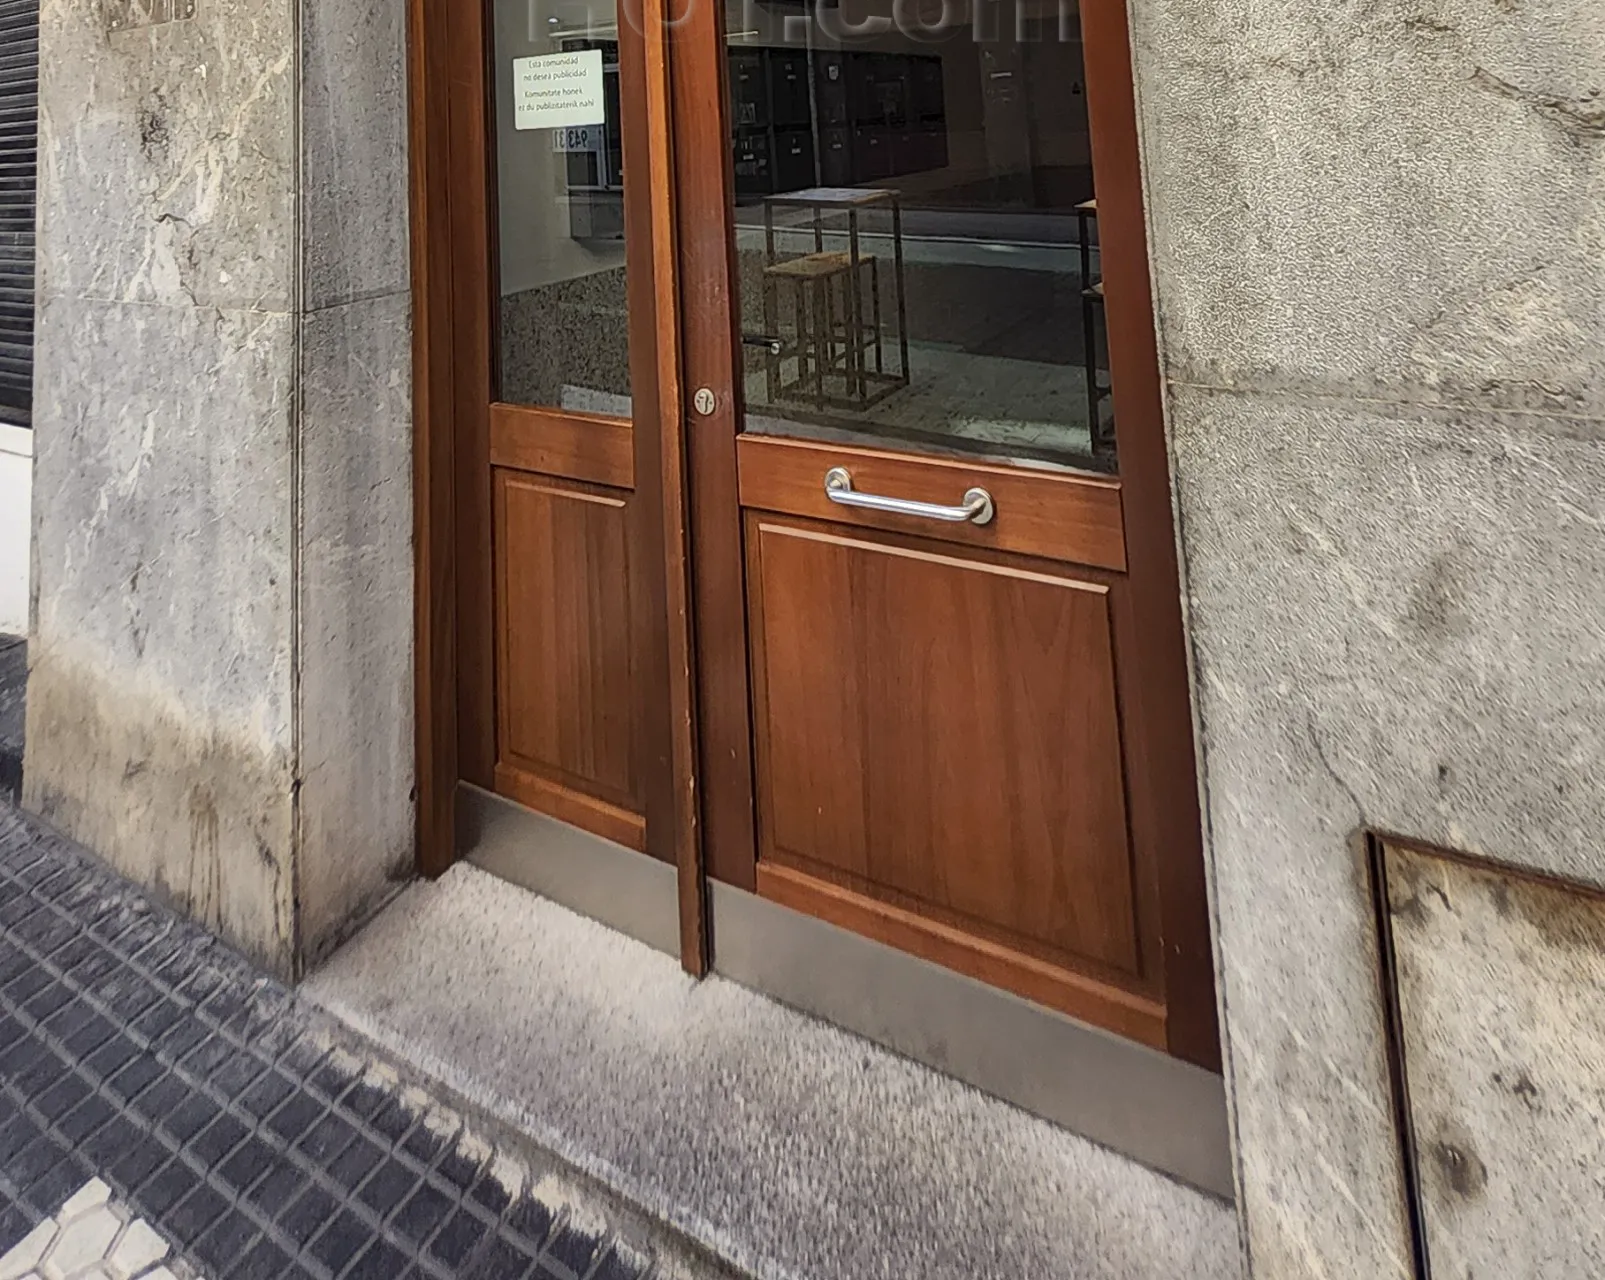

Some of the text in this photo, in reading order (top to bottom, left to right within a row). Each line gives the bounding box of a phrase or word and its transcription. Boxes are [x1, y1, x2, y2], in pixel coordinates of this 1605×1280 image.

[528, 56, 579, 69] Esta comunidad
[533, 72, 551, 81] desea
[553, 68, 587, 80] publicidad
[525, 86, 583, 98] Komunitate honek
[527, 103, 535, 111] du
[579, 99, 595, 108] nahi
